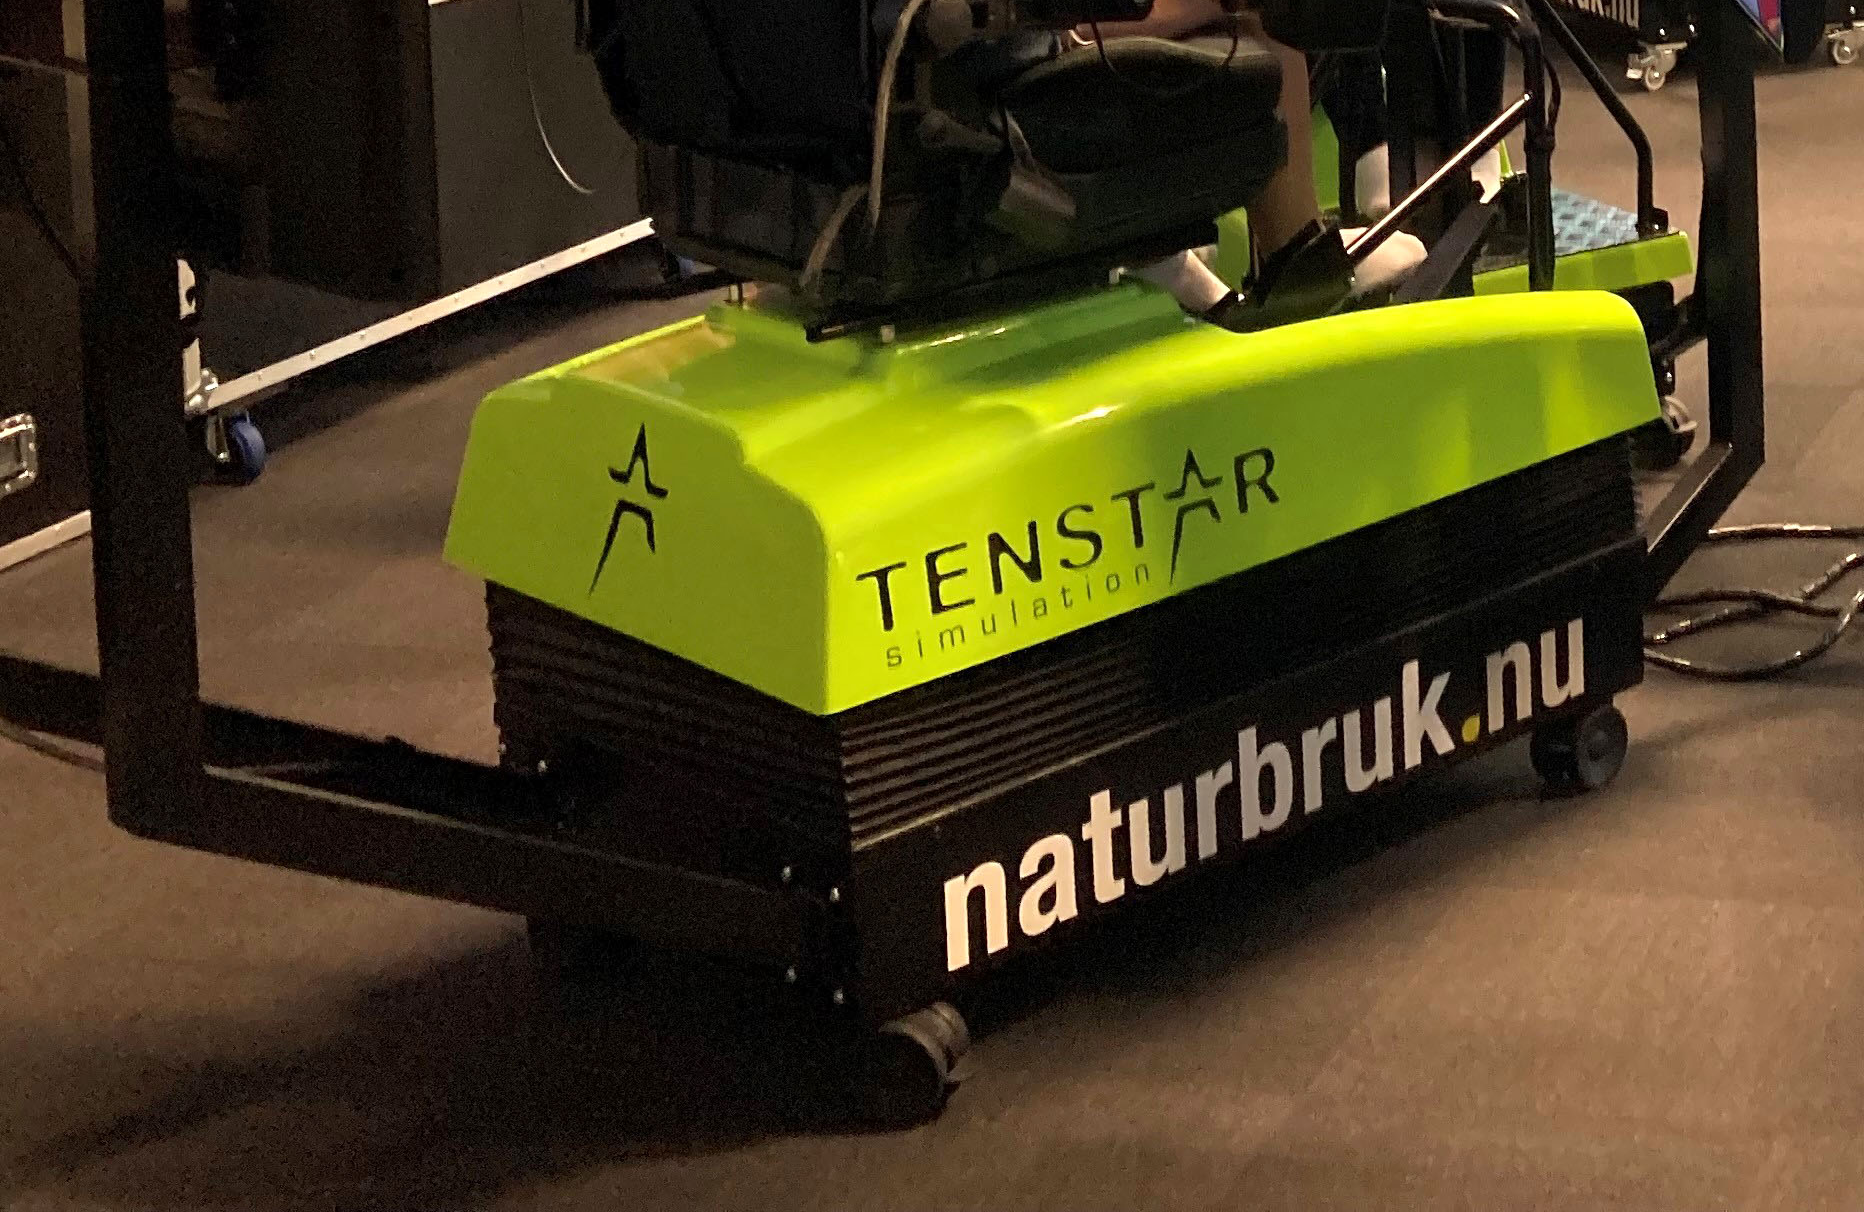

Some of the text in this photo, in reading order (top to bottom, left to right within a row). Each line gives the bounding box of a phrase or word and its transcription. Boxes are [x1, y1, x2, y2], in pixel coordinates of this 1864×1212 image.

[856, 447, 1280, 632] TENSTAR
[886, 560, 1150, 668] simulation
[942, 616, 1585, 973] naturbruk.nu
